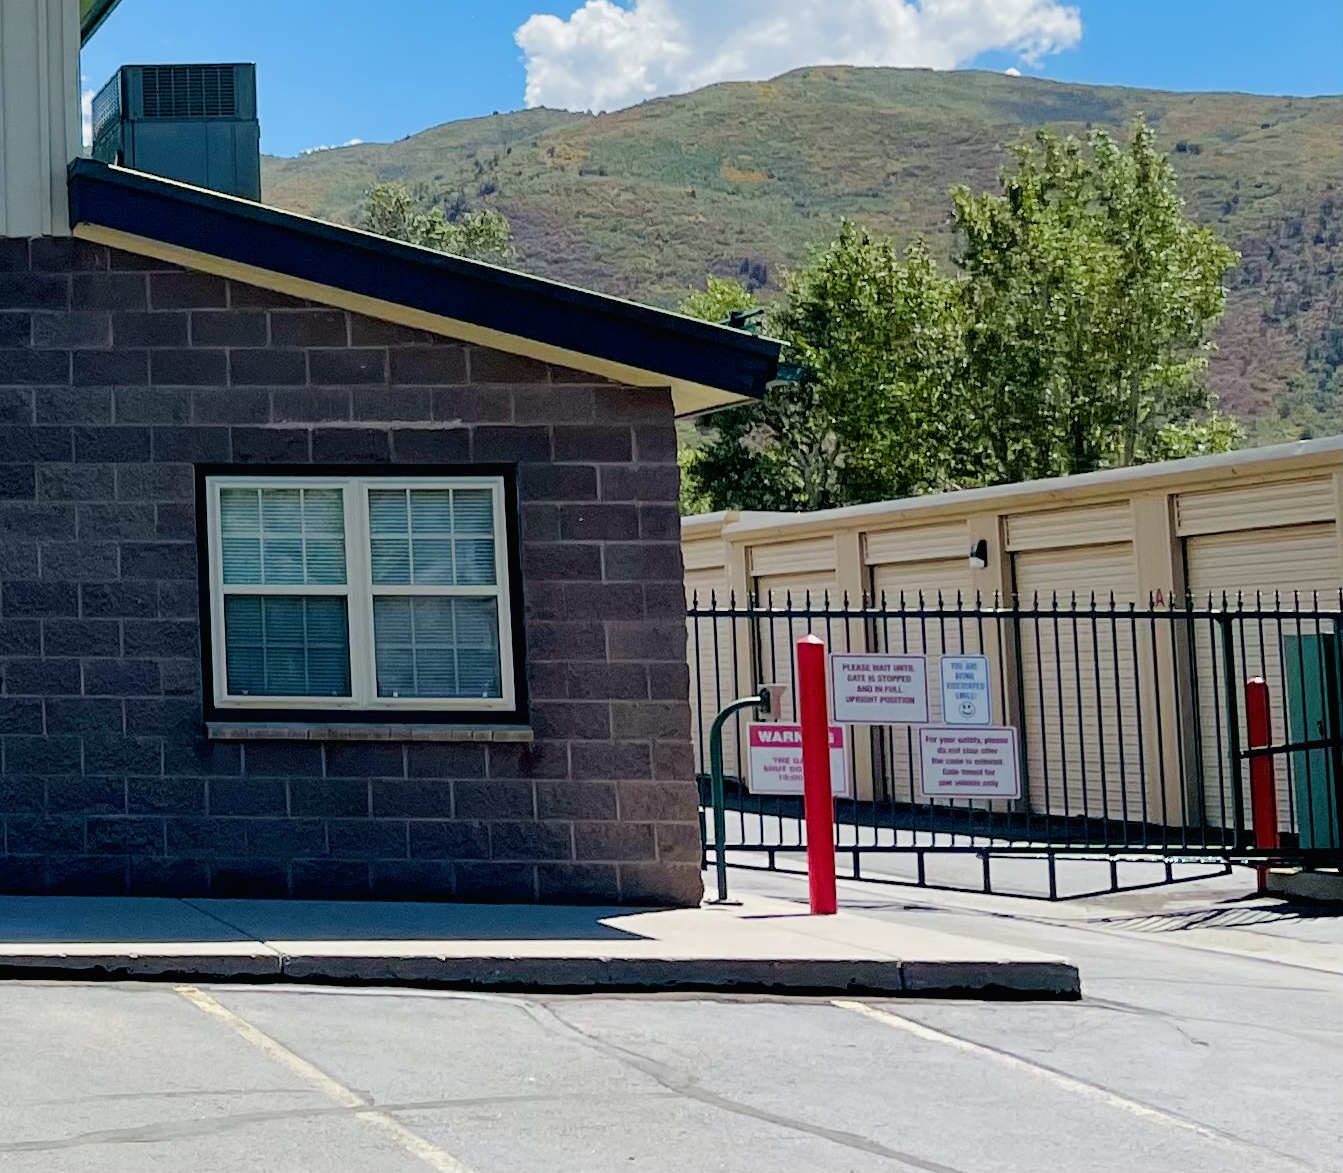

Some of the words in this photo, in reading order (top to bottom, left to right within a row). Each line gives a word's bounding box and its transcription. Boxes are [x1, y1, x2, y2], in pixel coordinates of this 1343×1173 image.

[1155, 588, 1165, 606] A
[842, 663, 870, 672] PLEASE
[872, 664, 891, 672] WAIT
[893, 664, 915, 672] UNTIL
[847, 674, 866, 682] GATE
[868, 674, 875, 682] IS
[877, 674, 912, 682] STOPPED
[856, 685, 873, 693] AND
[874, 685, 883, 693] IN
[884, 685, 902, 693] FULL
[879, 696, 915, 704] POSITION
[758, 730, 834, 743] WARN
